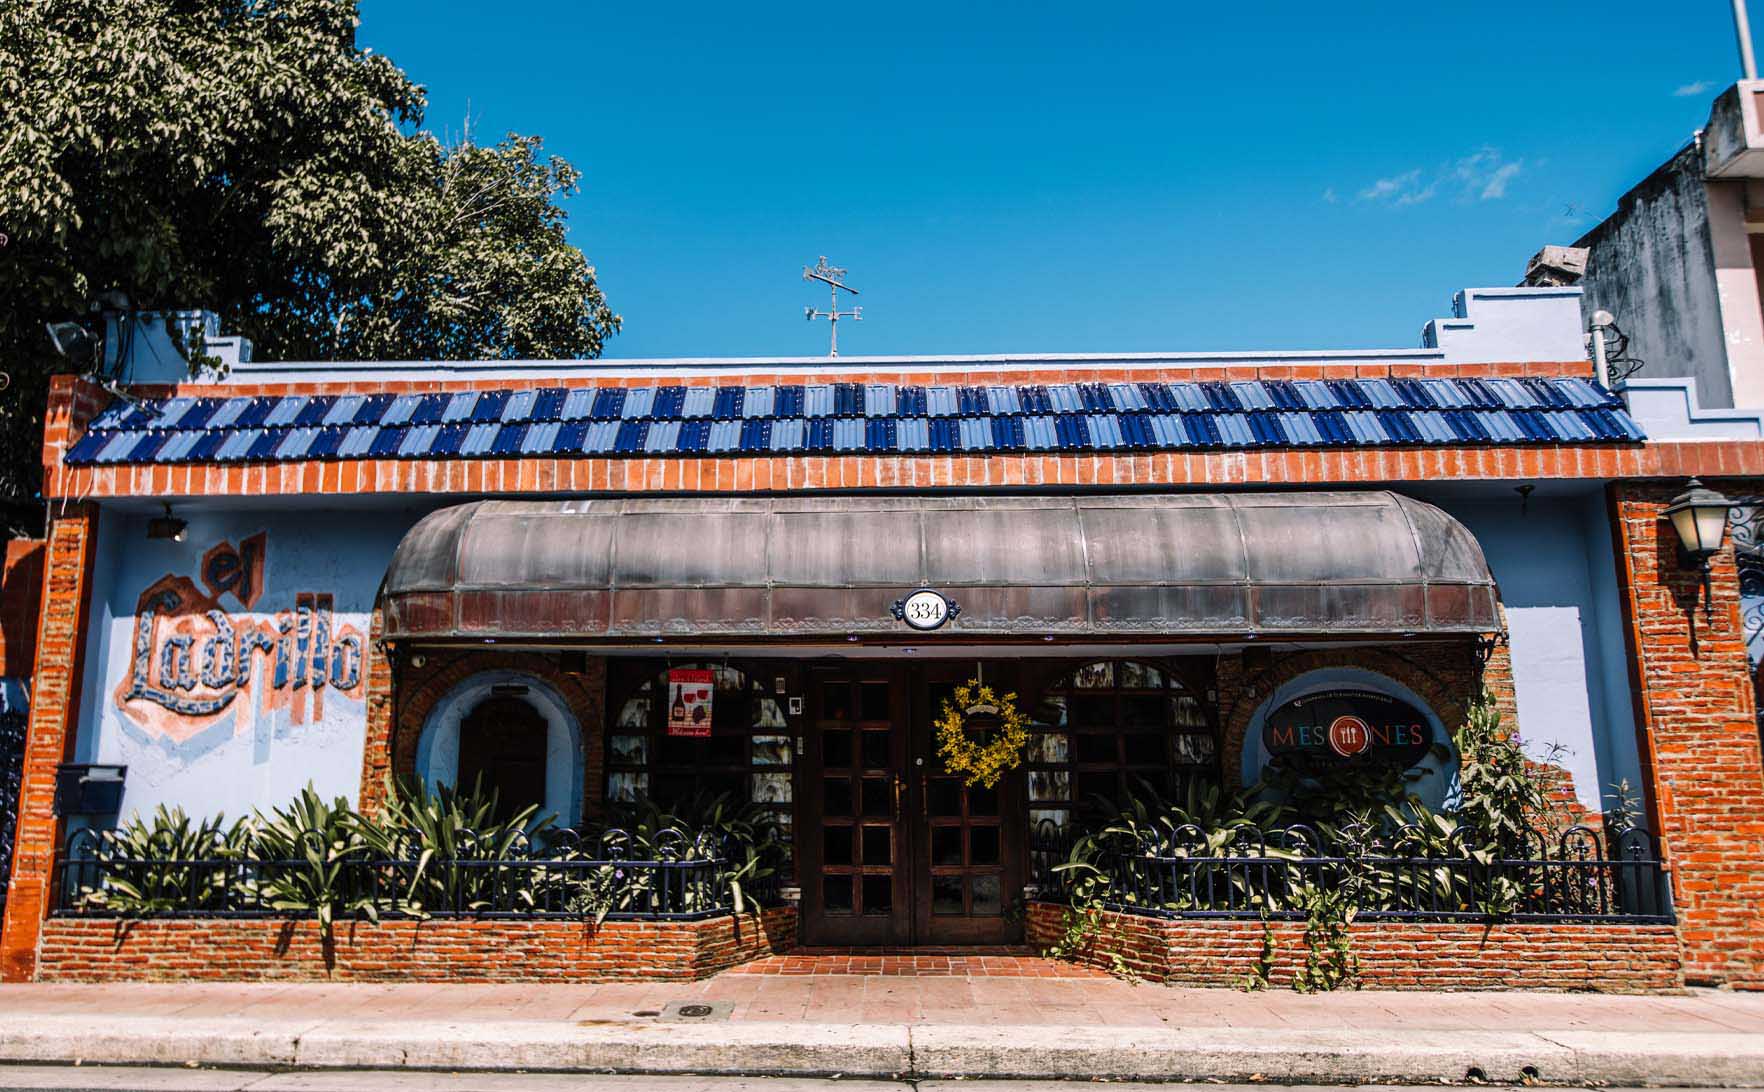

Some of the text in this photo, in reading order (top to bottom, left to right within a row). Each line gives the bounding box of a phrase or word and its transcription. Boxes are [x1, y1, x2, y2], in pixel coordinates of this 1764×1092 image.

[854, 306, 863, 320] E
[206, 540, 260, 604] el
[910, 602, 942, 619] 334
[123, 590, 362, 717] Ladrillo
